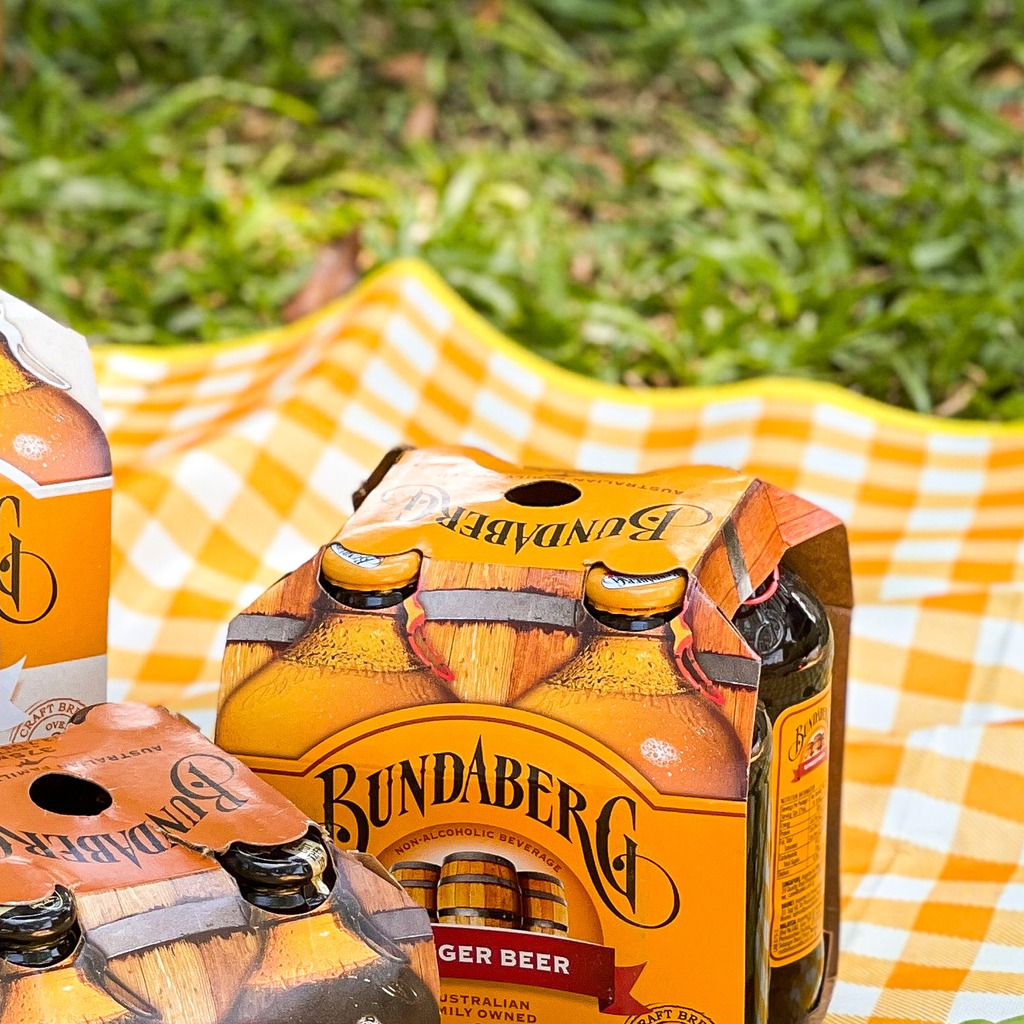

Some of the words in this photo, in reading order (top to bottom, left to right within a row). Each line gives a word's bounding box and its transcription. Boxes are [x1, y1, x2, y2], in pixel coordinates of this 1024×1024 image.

[19, 703, 54, 738] CRAFT
[45, 720, 66, 731] OVE
[314, 734, 680, 929] BUNDABERG
[394, 828, 495, 856] NON-ALCOHOLIC
[499, 833, 563, 873] BEVERAGE
[438, 943, 492, 965] GER
[500, 948, 570, 975] BEER
[439, 993, 530, 1010] USTRALIAN
[439, 1006, 473, 1017] MILY
[477, 1009, 537, 1023] OWNED
